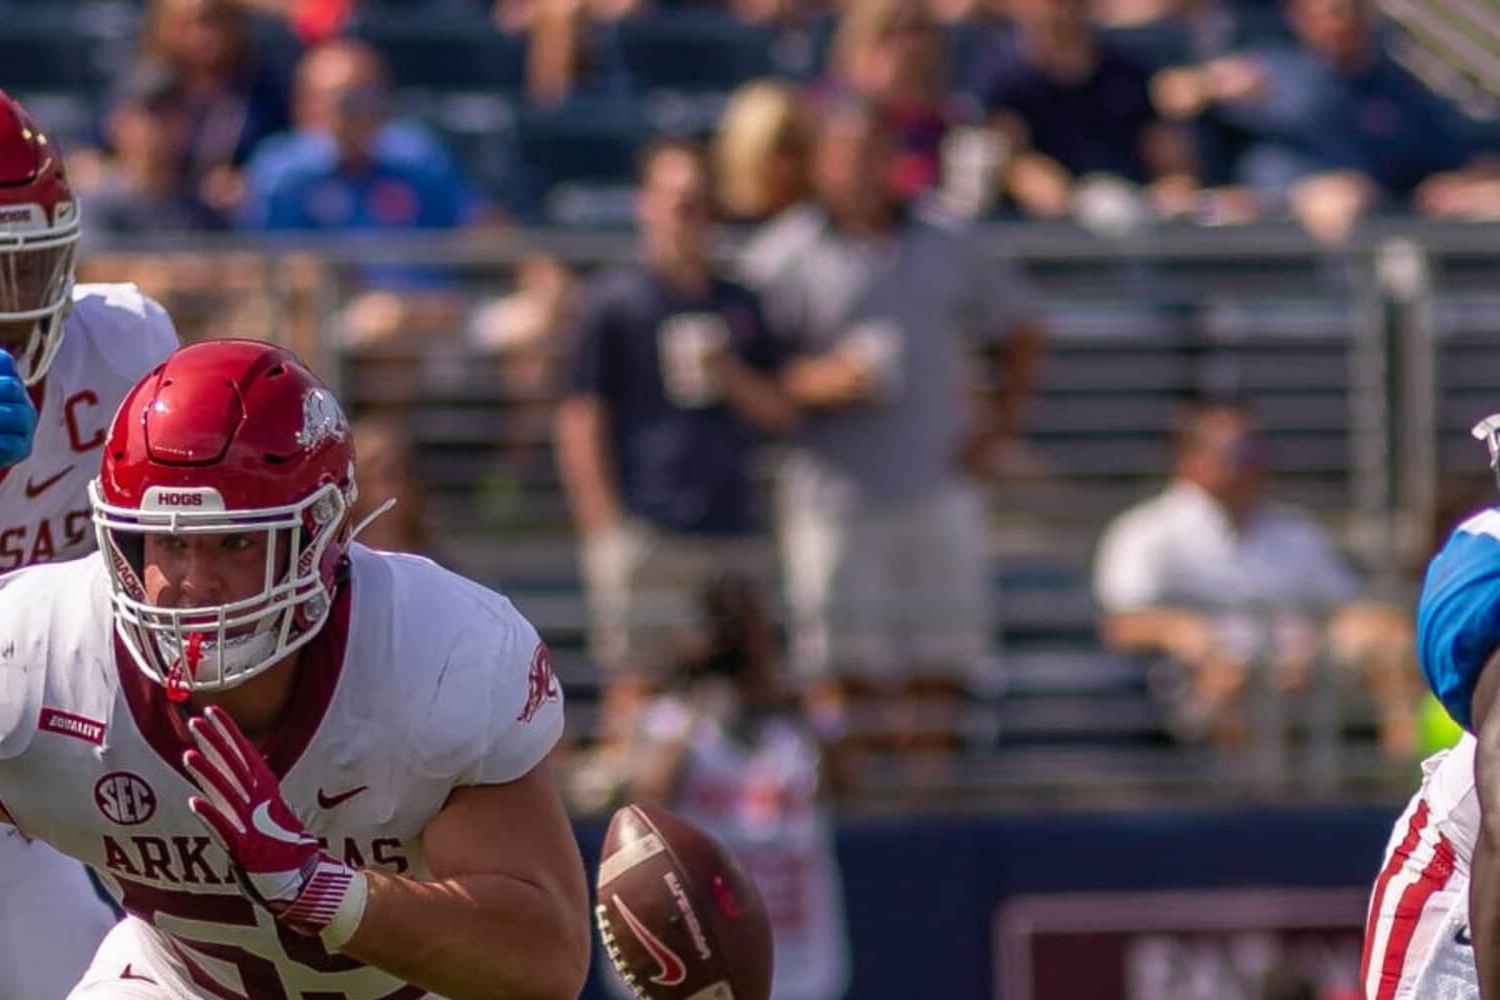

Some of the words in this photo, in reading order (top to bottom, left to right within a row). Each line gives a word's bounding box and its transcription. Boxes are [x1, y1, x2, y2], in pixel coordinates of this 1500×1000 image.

[64, 389, 105, 453] C
[158, 492, 203, 506] HOGS
[99, 777, 151, 821] SEC
